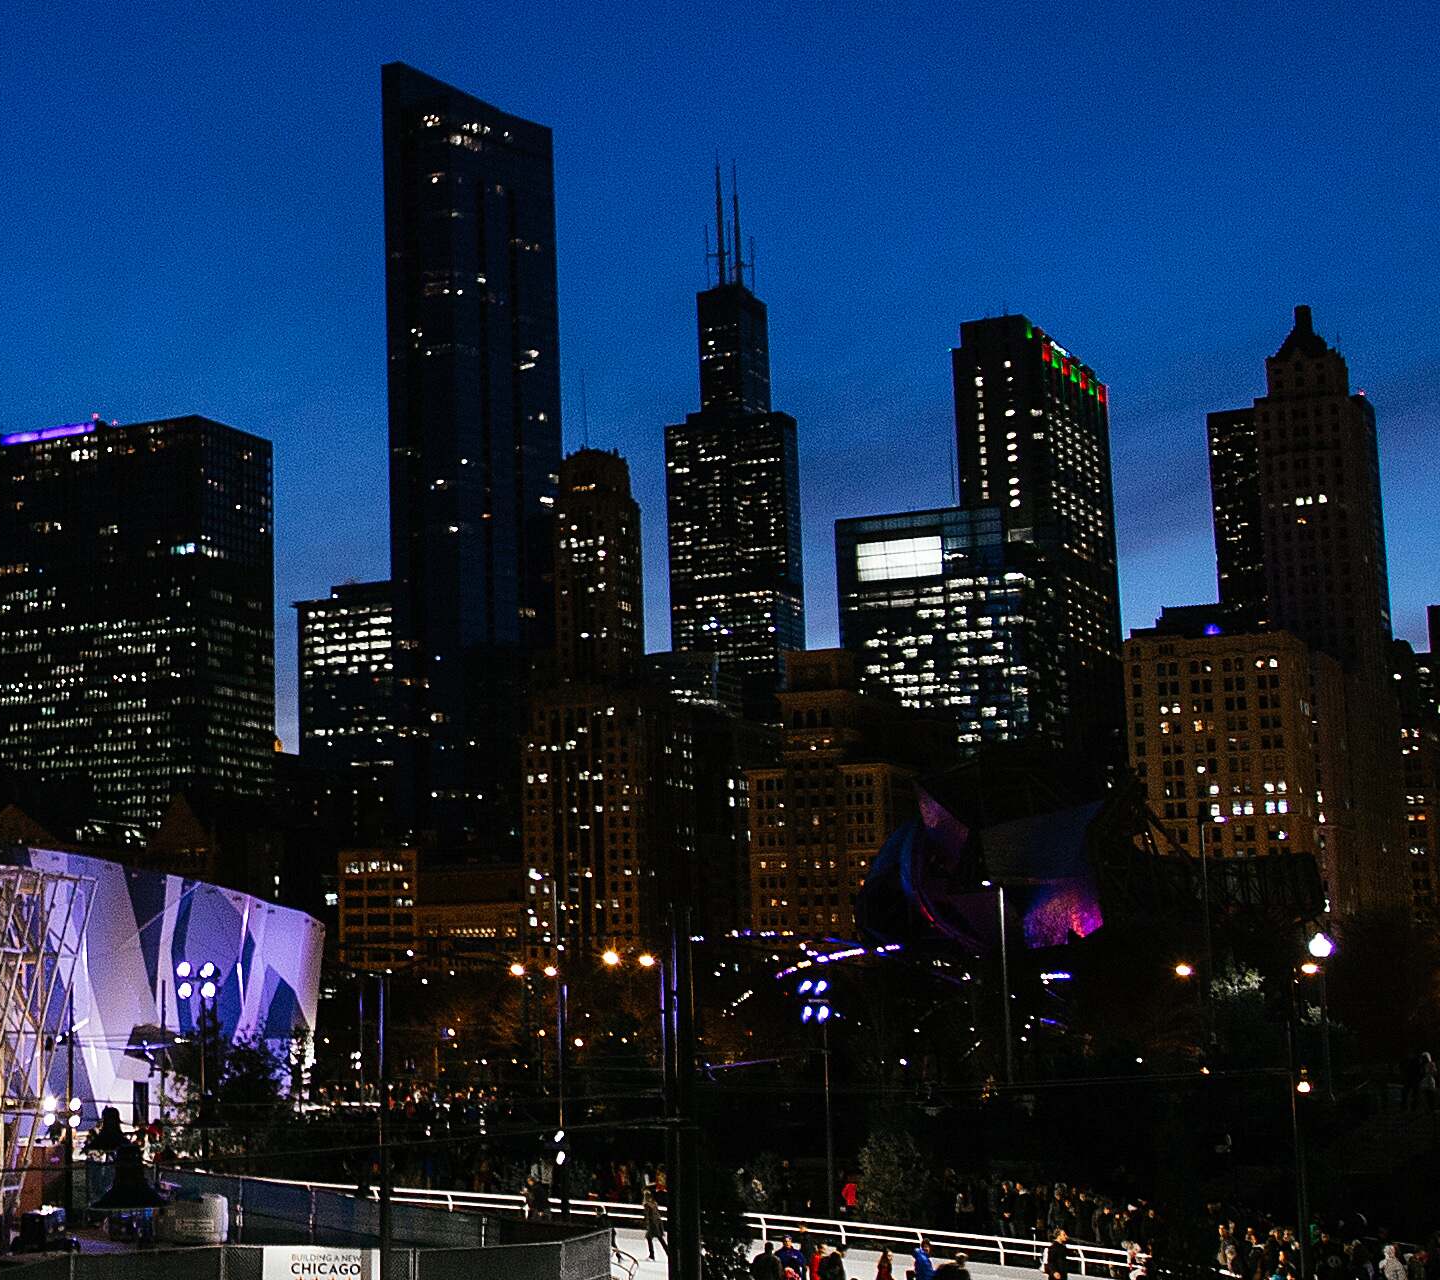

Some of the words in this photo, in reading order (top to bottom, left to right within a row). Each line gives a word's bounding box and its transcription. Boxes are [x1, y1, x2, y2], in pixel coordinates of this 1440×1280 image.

[291, 1253, 333, 1262] BUILDING
[341, 1254, 362, 1263] NEW
[290, 1262, 361, 1275] CHICAGO
